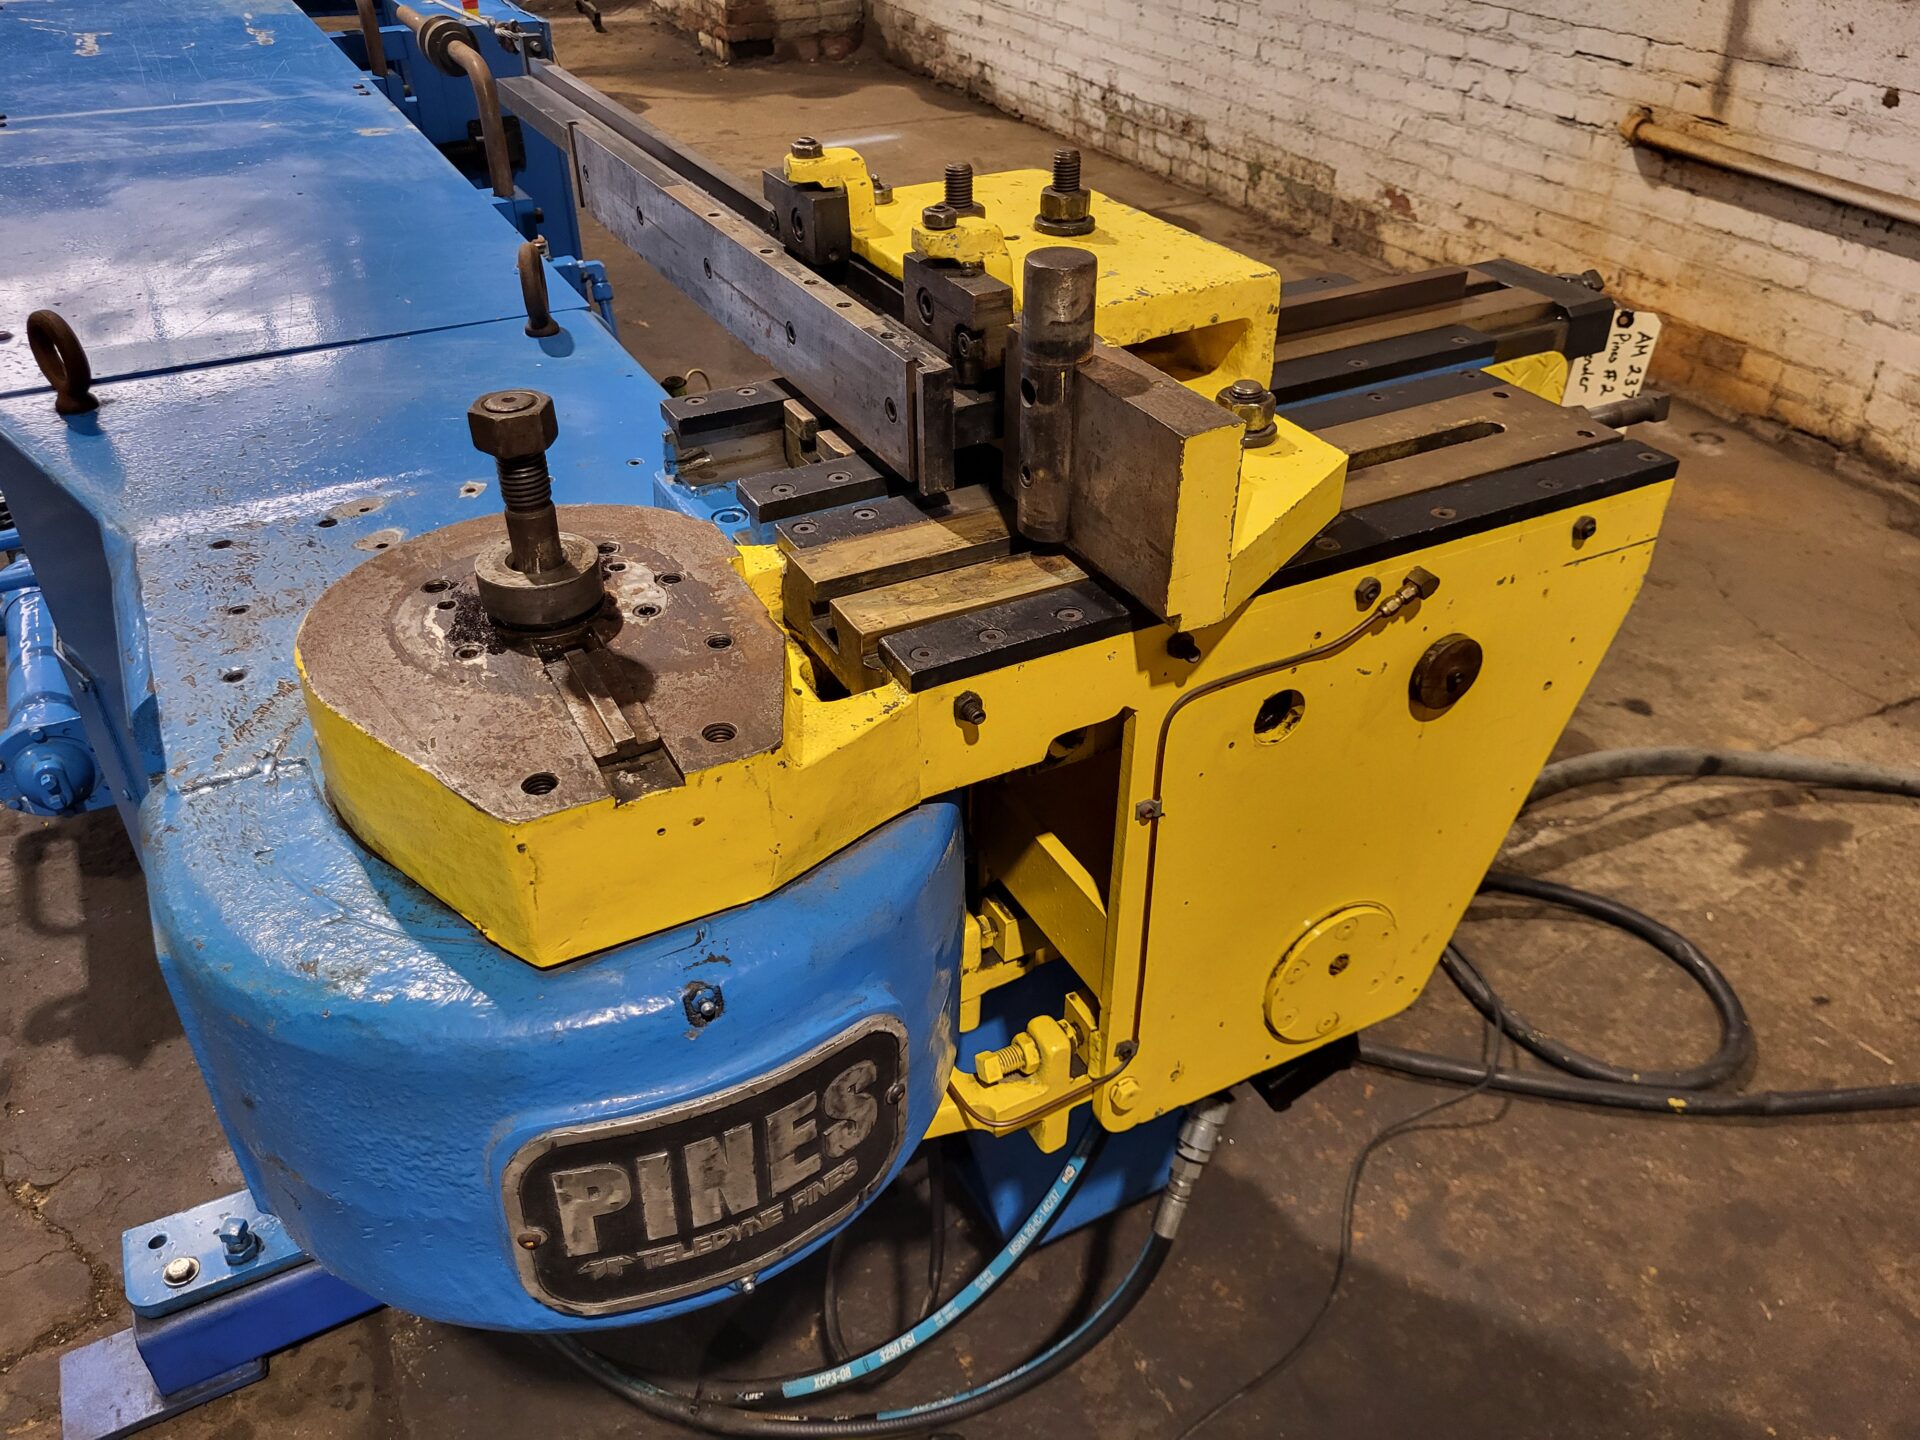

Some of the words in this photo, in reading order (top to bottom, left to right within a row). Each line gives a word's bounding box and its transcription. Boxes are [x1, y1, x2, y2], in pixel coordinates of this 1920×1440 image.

[1579, 354, 1595, 393] ender
[1630, 331, 1654, 358] AM
[551, 1059, 878, 1258] PINES
[636, 1201, 785, 1271] TELEDYNE
[790, 1156, 860, 1215] PINES
[813, 1366, 852, 1390] XCP3-08
[900, 1332, 916, 1351] PSI
